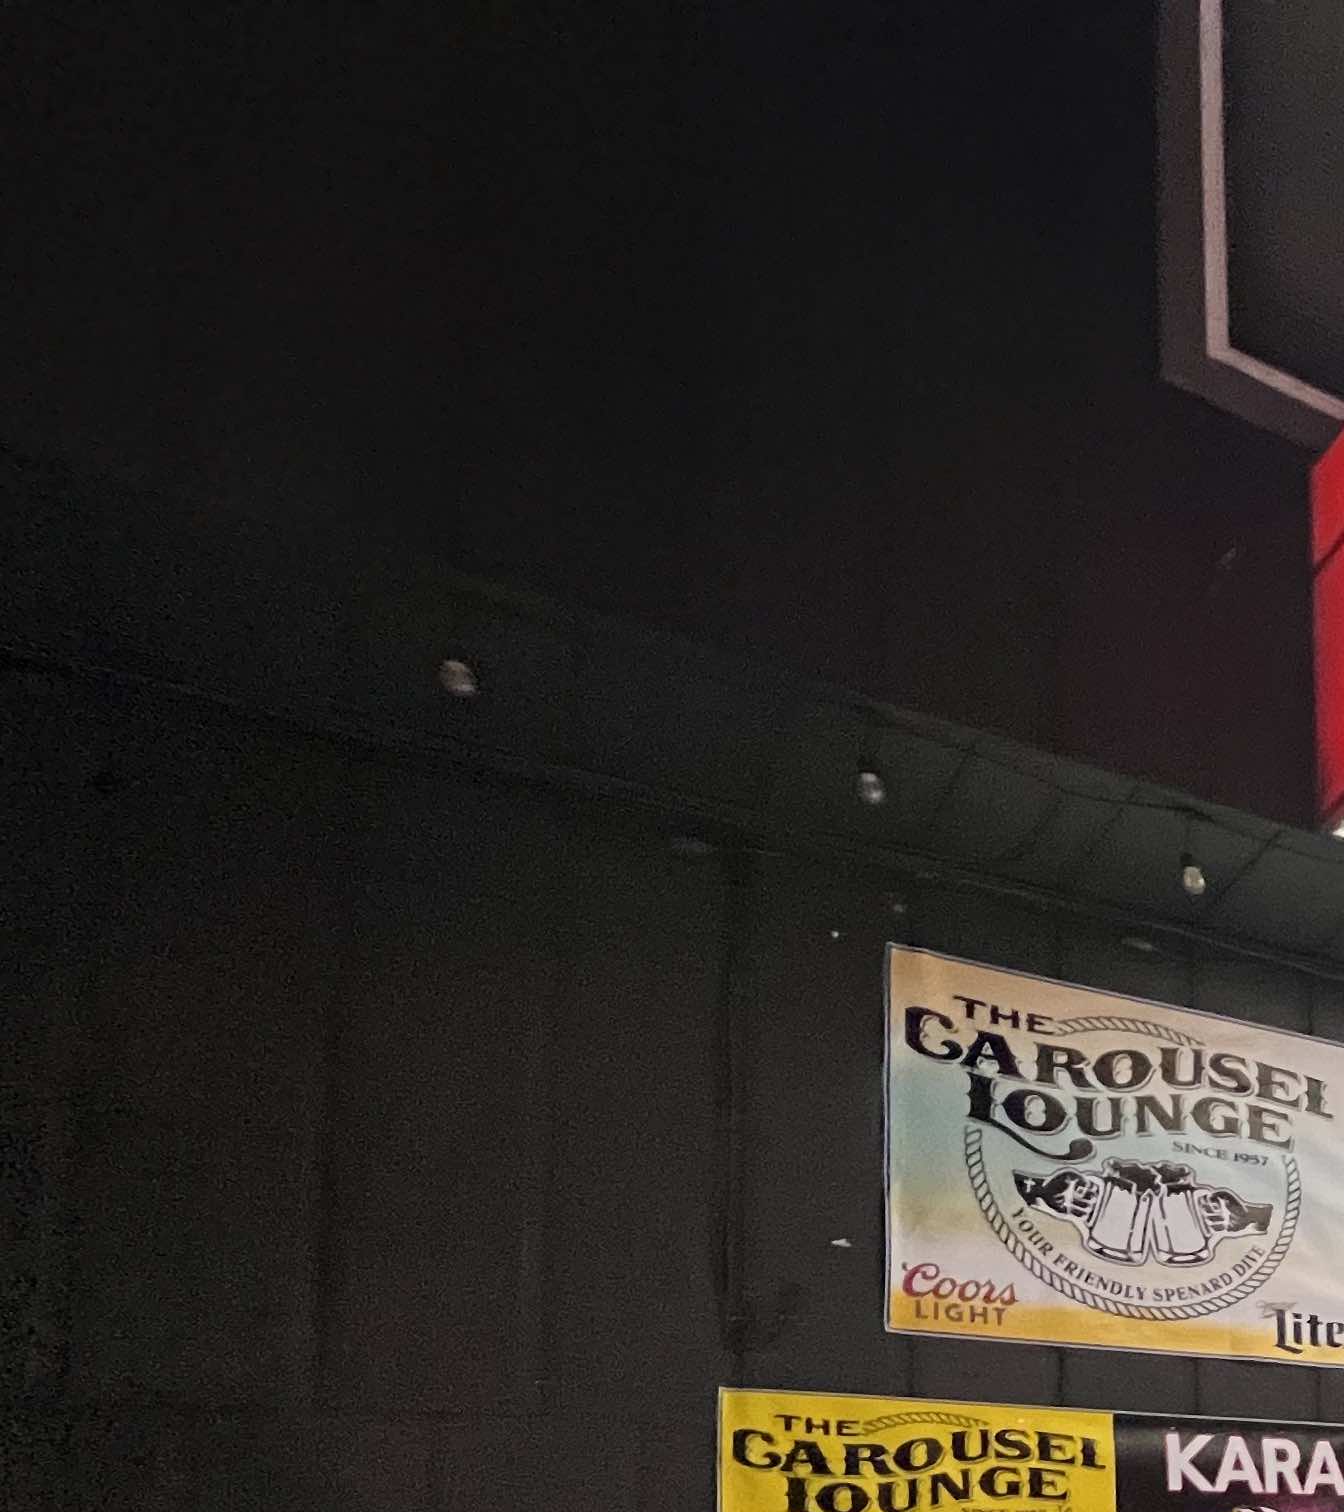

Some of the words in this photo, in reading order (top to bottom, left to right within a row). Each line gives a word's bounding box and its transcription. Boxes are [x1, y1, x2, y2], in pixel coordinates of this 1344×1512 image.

[952, 994, 1055, 1035] THE
[905, 1006, 1335, 1119] CAROUSEL
[966, 1071, 1296, 1161] LOUNGE
[1172, 1140, 1229, 1161] SINCE
[1233, 1151, 1269, 1167] 1957
[1011, 1206, 1053, 1257] YOUR
[1053, 1253, 1148, 1301] FRIENDLY
[1152, 1271, 1233, 1303] SPENARD
[1232, 1246, 1266, 1280] DIVE
[901, 1261, 1019, 1306] Coors
[915, 1301, 1006, 1327] LIGHT
[774, 1413, 861, 1437] THE
[732, 1427, 1107, 1477] CAROUSEL
